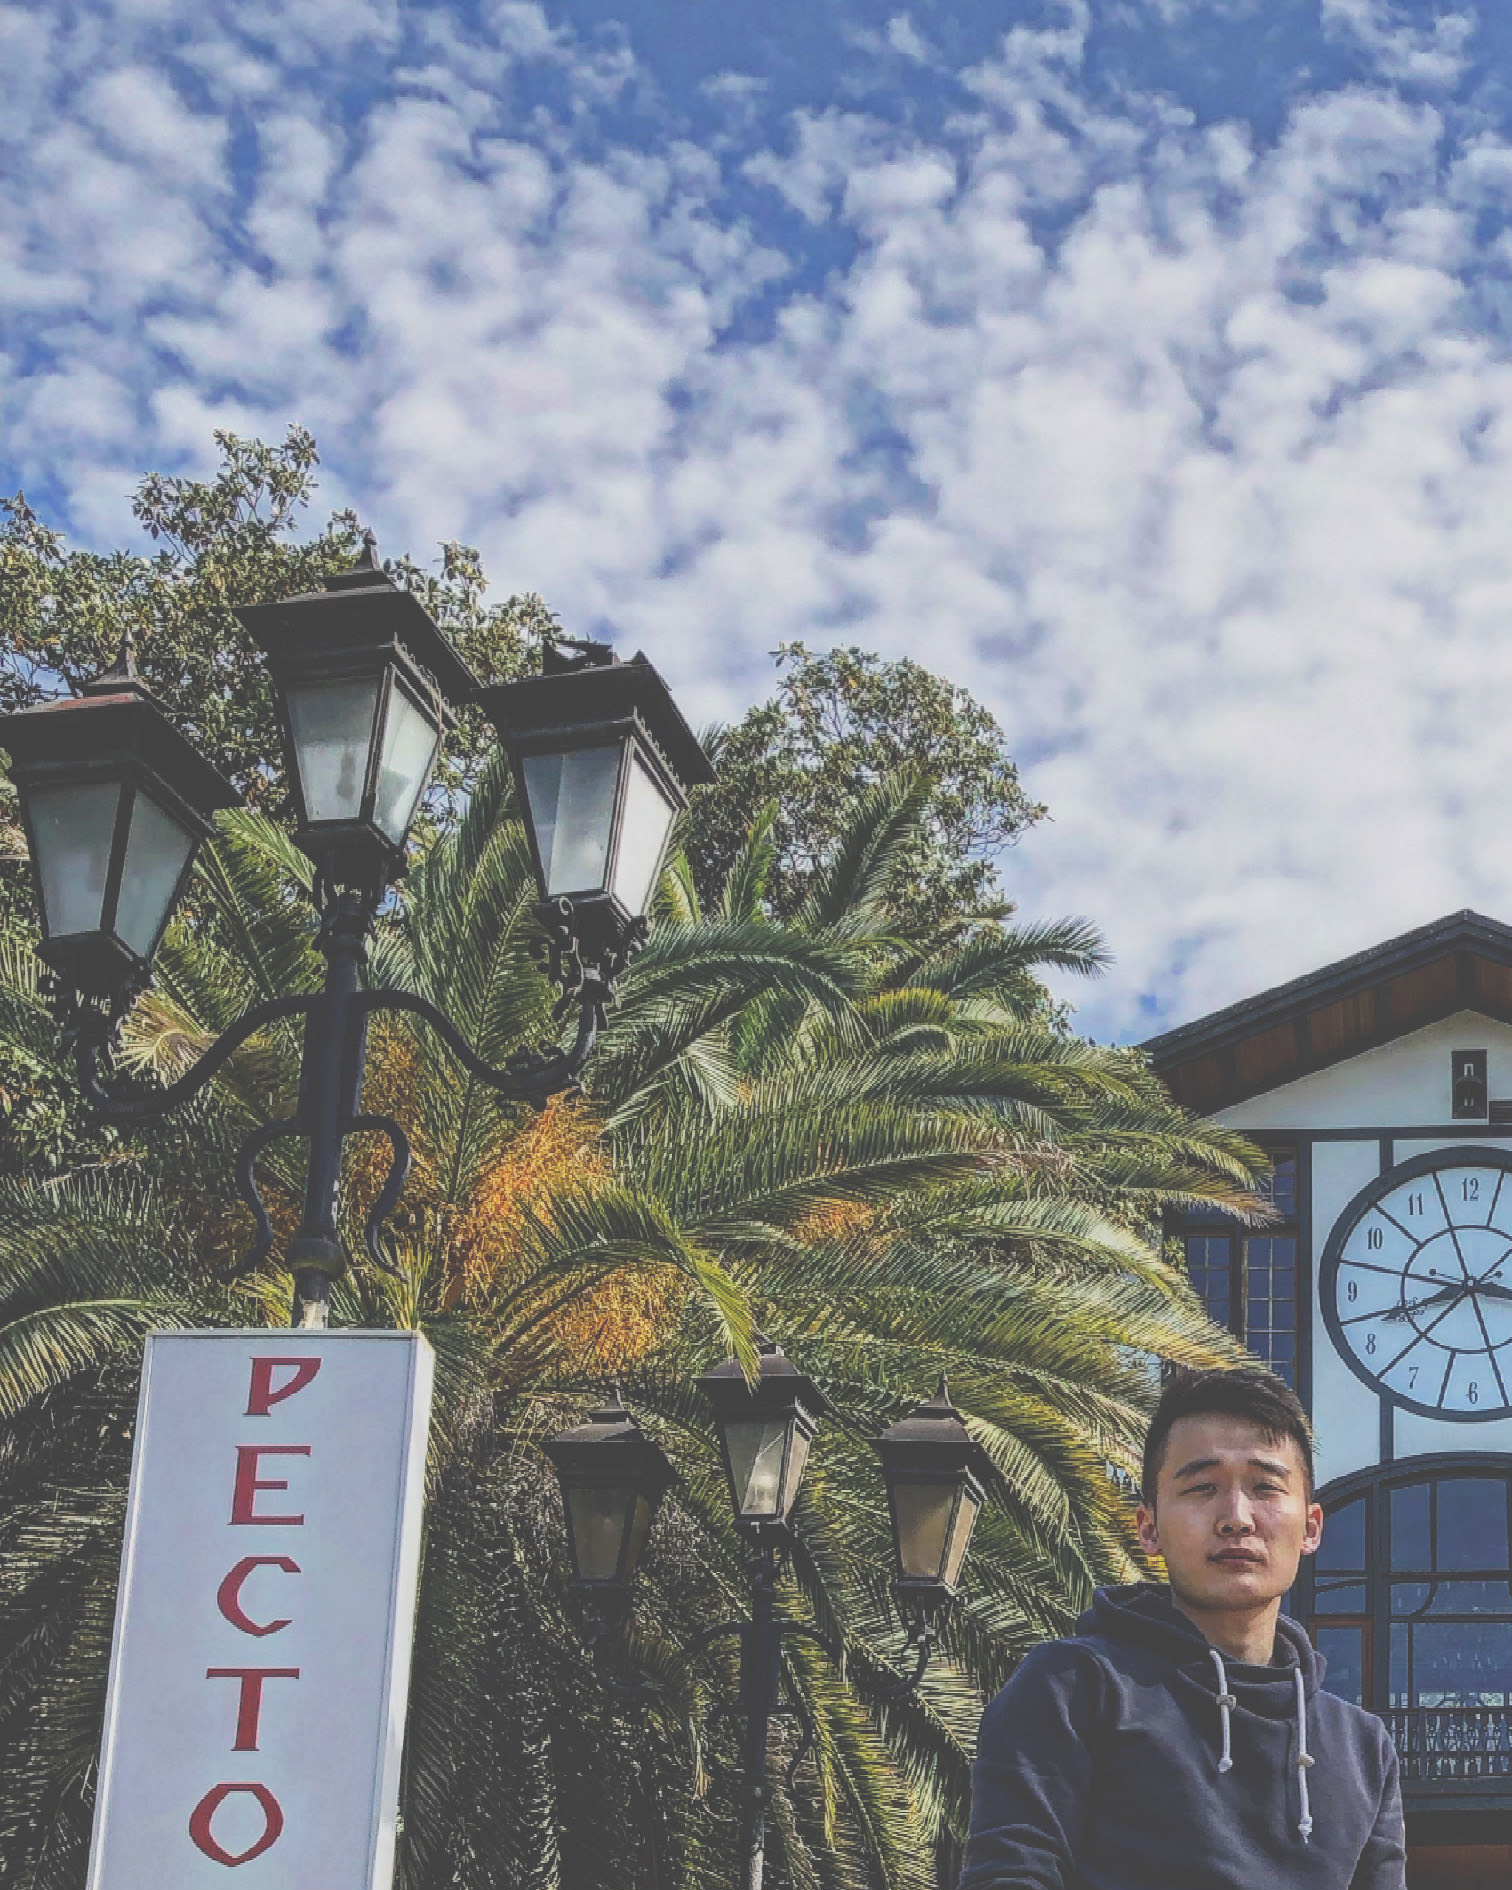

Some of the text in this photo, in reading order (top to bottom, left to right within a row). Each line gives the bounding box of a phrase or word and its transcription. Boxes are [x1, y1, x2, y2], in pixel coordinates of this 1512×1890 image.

[1461, 1177, 1480, 1202] 12
[1407, 1192, 1424, 1216] 11
[1367, 1226, 1384, 1250] 10
[1347, 1281, 1358, 1303] 9
[1364, 1333, 1377, 1355] 8
[1408, 1366, 1420, 1390] 7
[1465, 1382, 1479, 1405] 6
